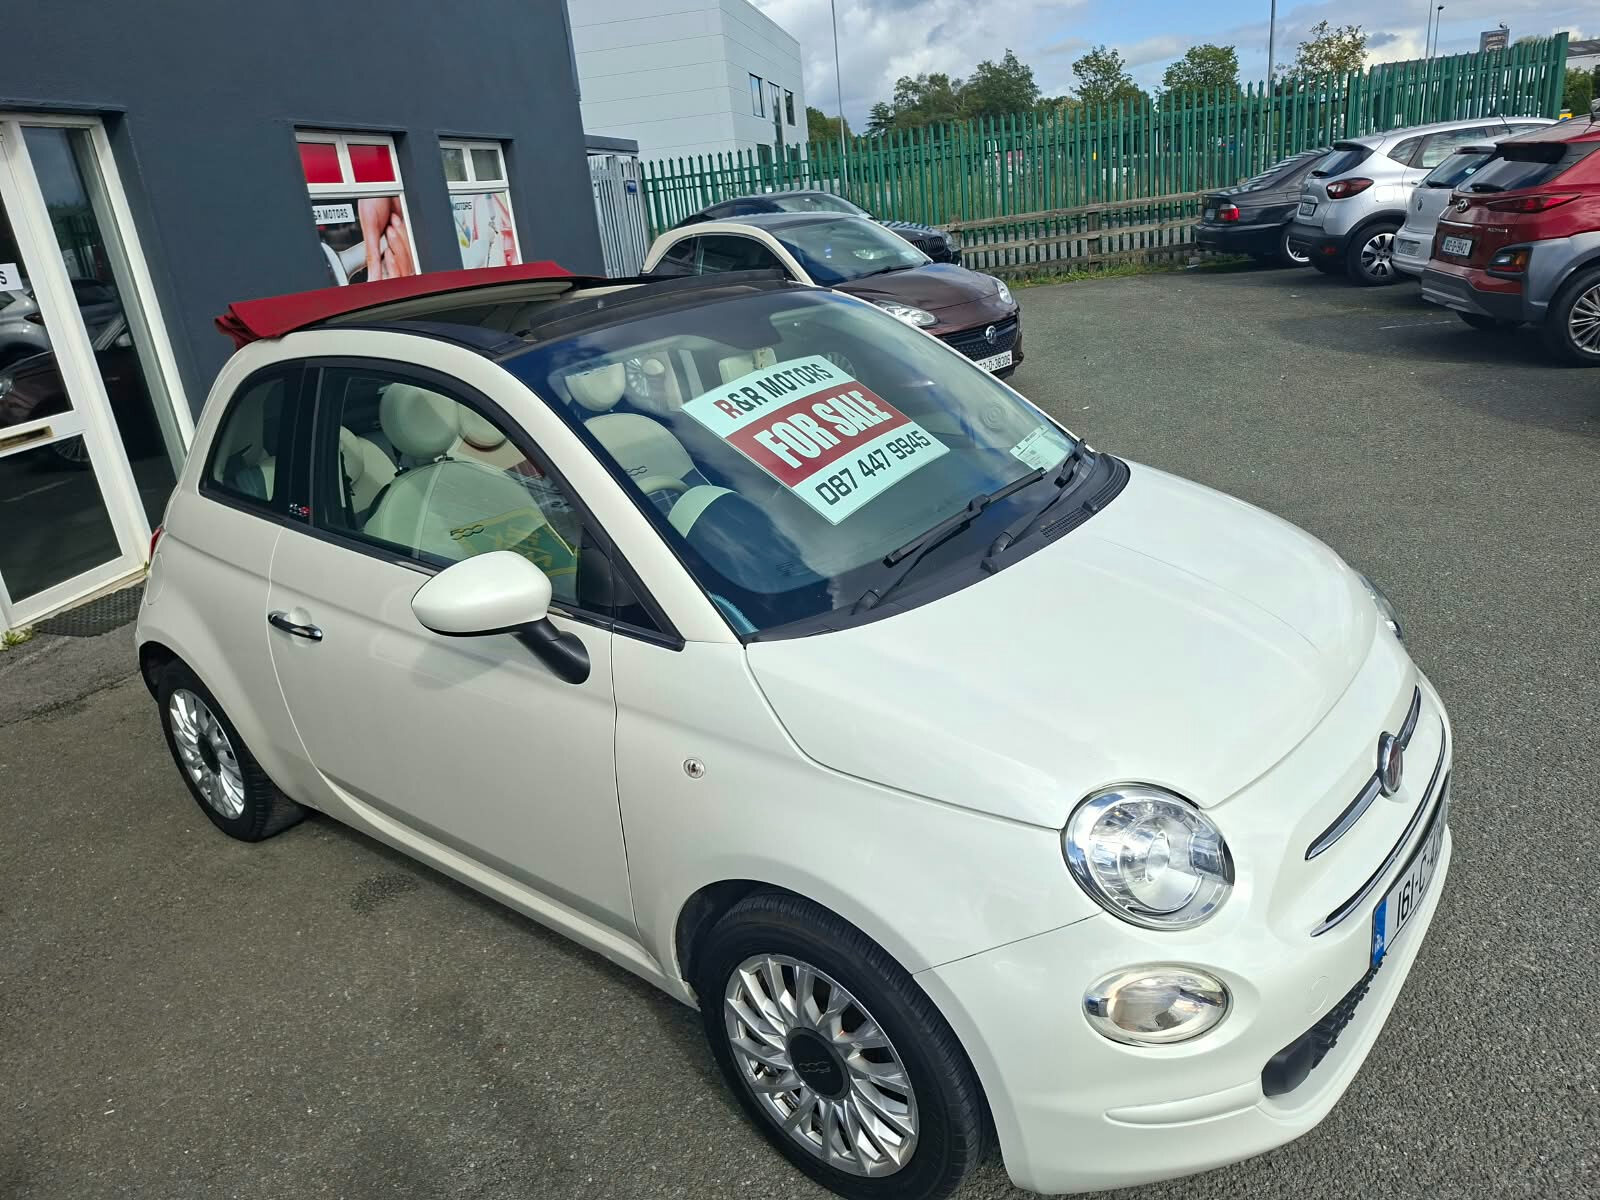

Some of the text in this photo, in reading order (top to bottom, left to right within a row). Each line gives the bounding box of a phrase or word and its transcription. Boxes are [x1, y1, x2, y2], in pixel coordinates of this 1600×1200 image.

[323, 208, 349, 219] MOTORS
[713, 363, 834, 420] R&R MOTORS
[753, 390, 893, 469] FOR SALE
[814, 430, 932, 506] 087 447 9945
